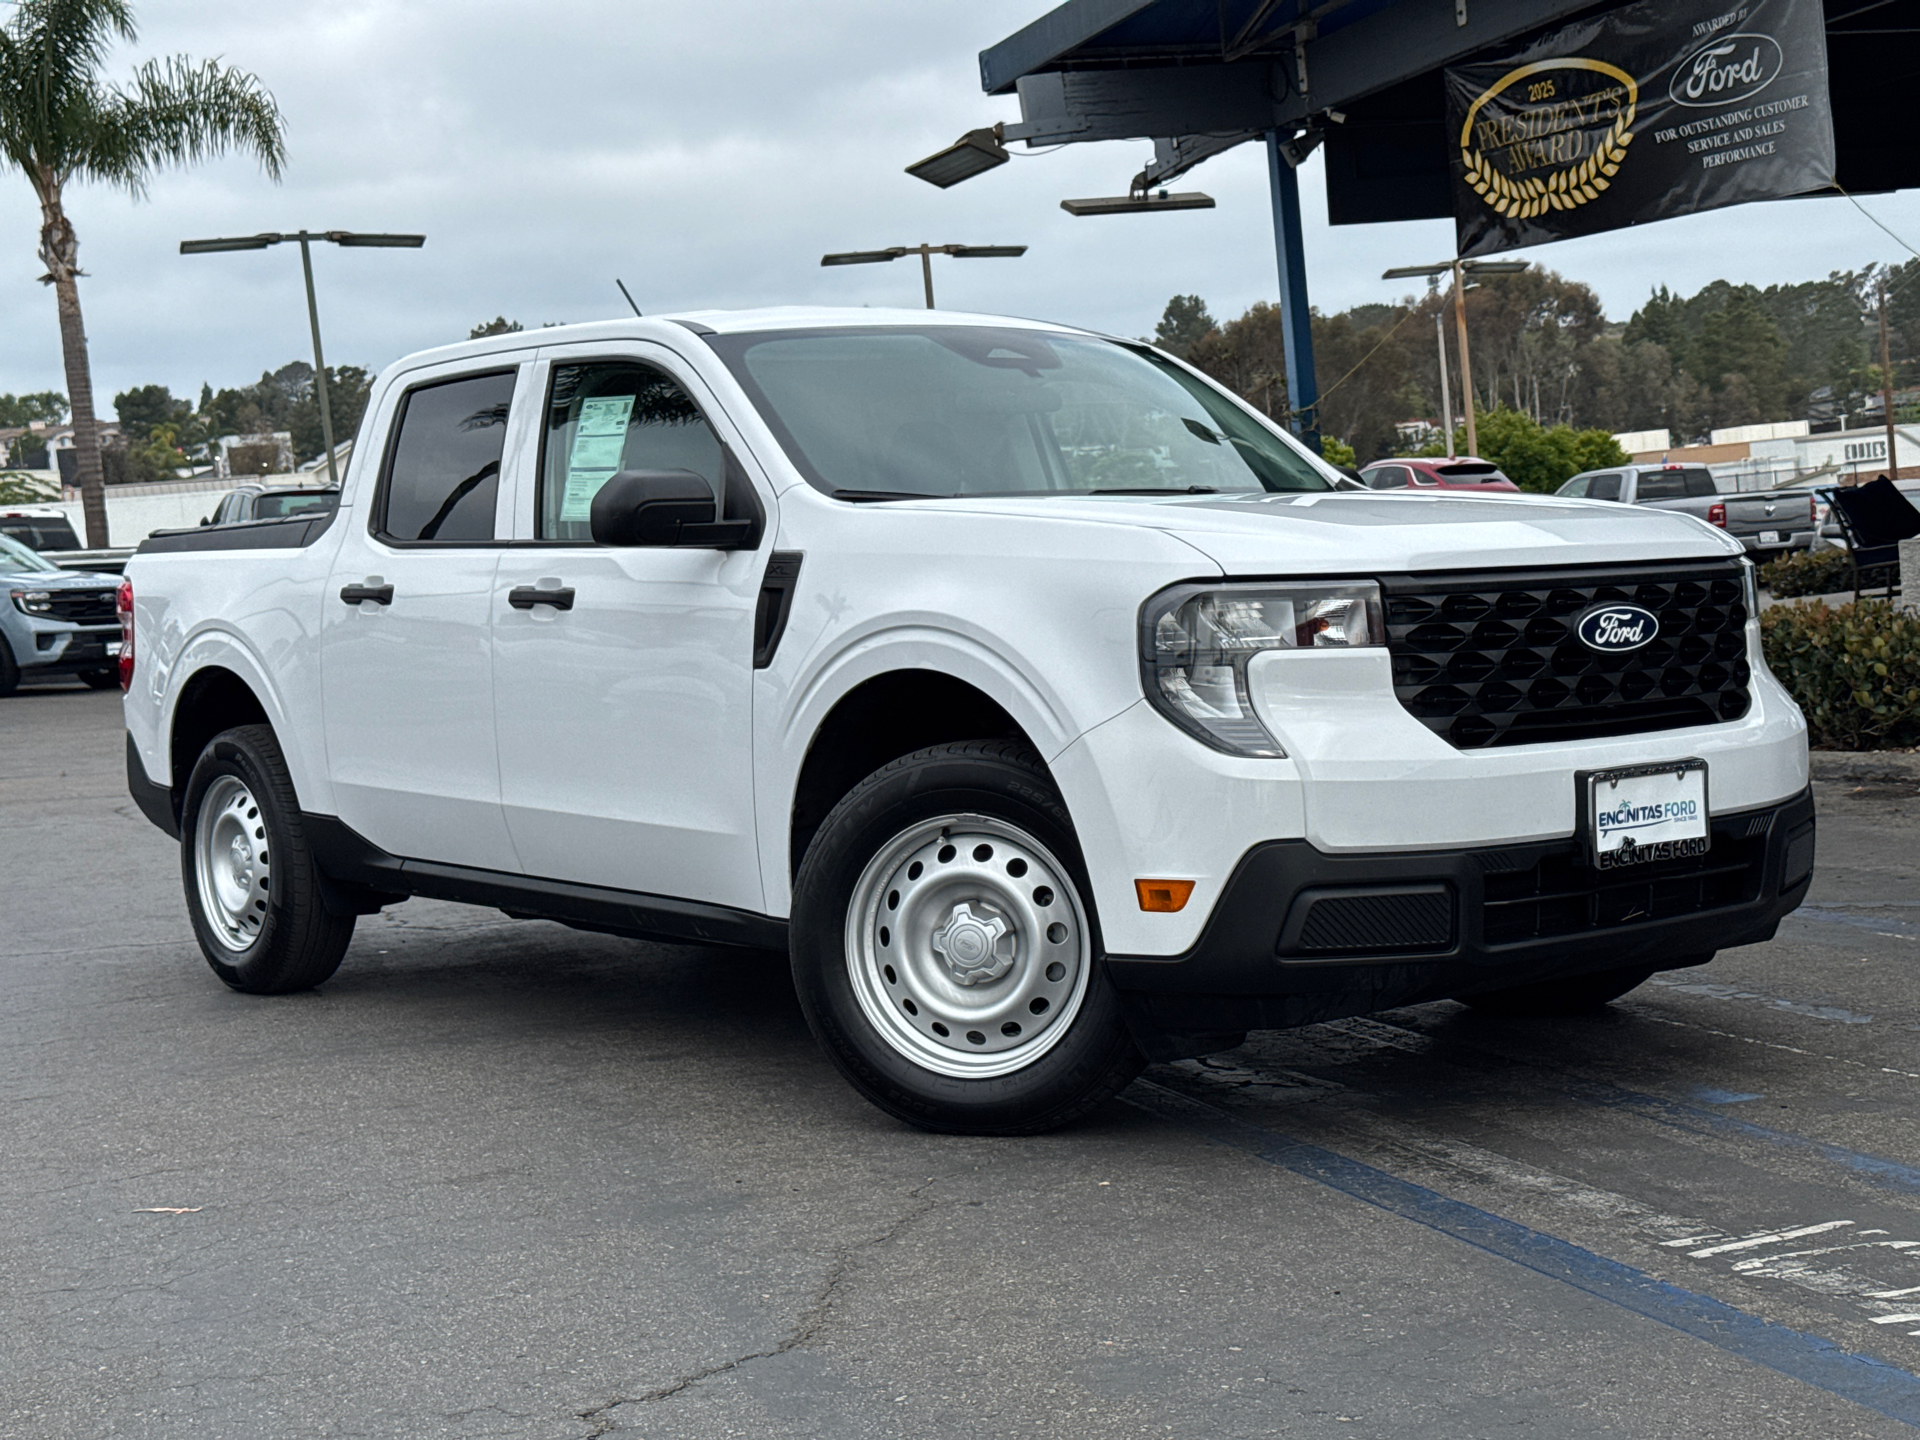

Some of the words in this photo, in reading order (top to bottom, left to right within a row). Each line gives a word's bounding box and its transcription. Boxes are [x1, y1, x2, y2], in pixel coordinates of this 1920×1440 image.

[1692, 12, 1737, 37] AWARDED
[1686, 43, 1763, 99] Ford
[1528, 80, 1556, 102] 2025
[1654, 128, 1678, 144] FOR
[1679, 109, 1752, 137] OUTSTANDING
[1753, 95, 1809, 119] CUSTOMER
[1509, 130, 1583, 174] AWARD
[1687, 134, 1730, 154] SERVICE
[1732, 127, 1753, 143] AND
[1754, 120, 1785, 138] SALES
[1702, 140, 1776, 169] PERFORMANCE
[1595, 612, 1645, 644] Ford
[1598, 802, 1663, 828] ENCINITAS
[1664, 799, 1697, 818] FORD
[1600, 842, 1671, 870] ENCINITAS
[1671, 837, 1706, 859] FORD
